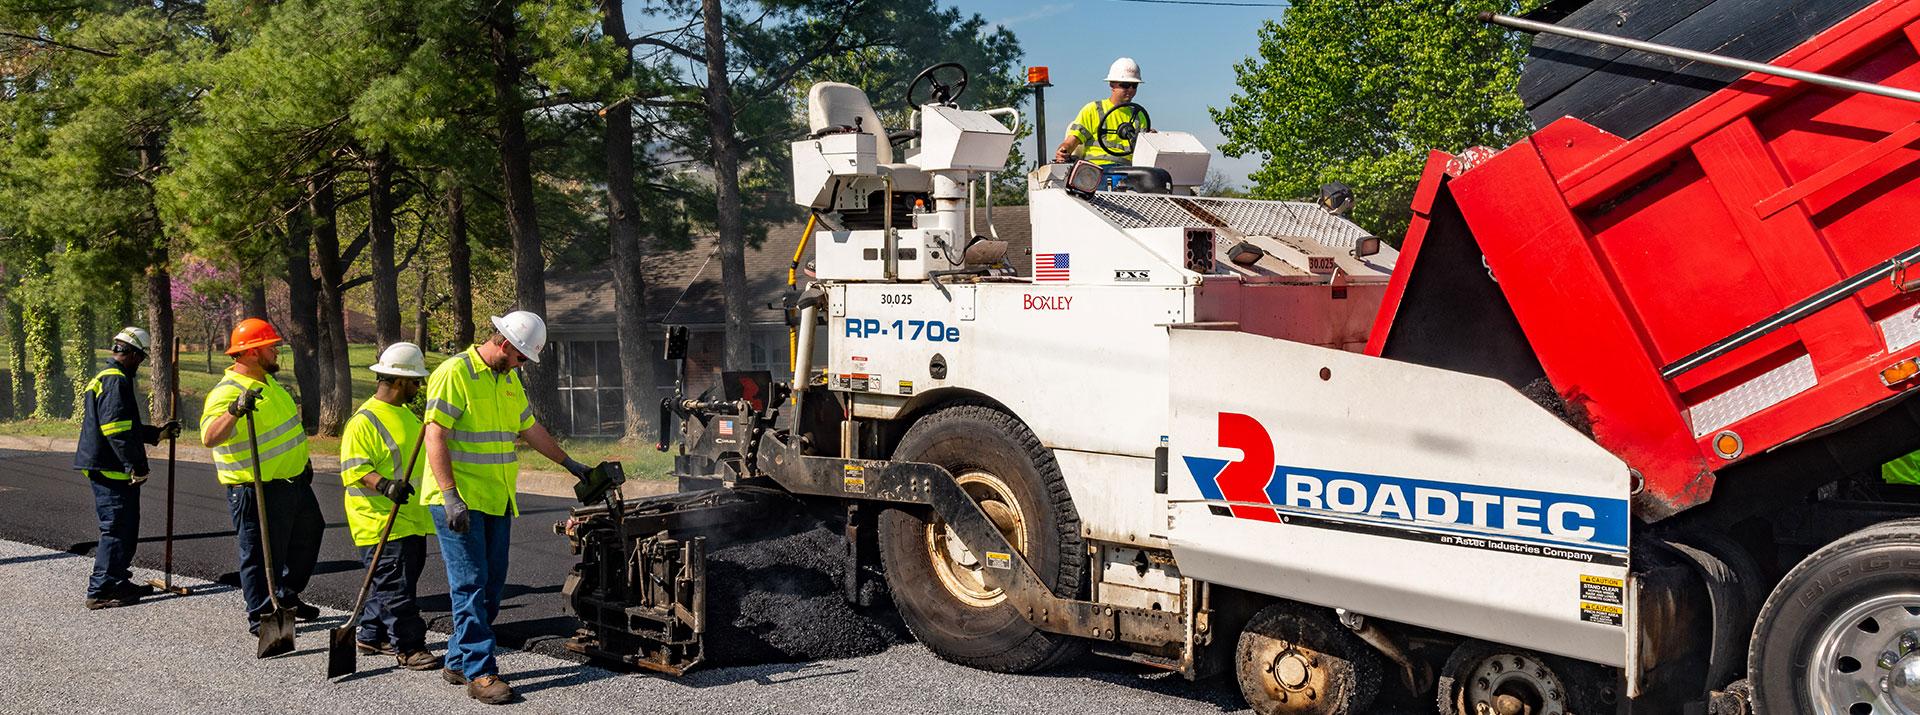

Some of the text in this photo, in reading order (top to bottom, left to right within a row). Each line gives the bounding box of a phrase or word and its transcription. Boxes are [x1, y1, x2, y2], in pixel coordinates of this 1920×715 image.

[1309, 258, 1334, 270] 30.025
[881, 293, 913, 305] 30.025
[845, 318, 960, 342] RP-170e
[1285, 473, 1596, 542] ROADTEC
[1440, 535, 1594, 562] an Astec Industries Company
[1591, 577, 1618, 585] CAUTION
[1591, 604, 1618, 612] CAUTION
